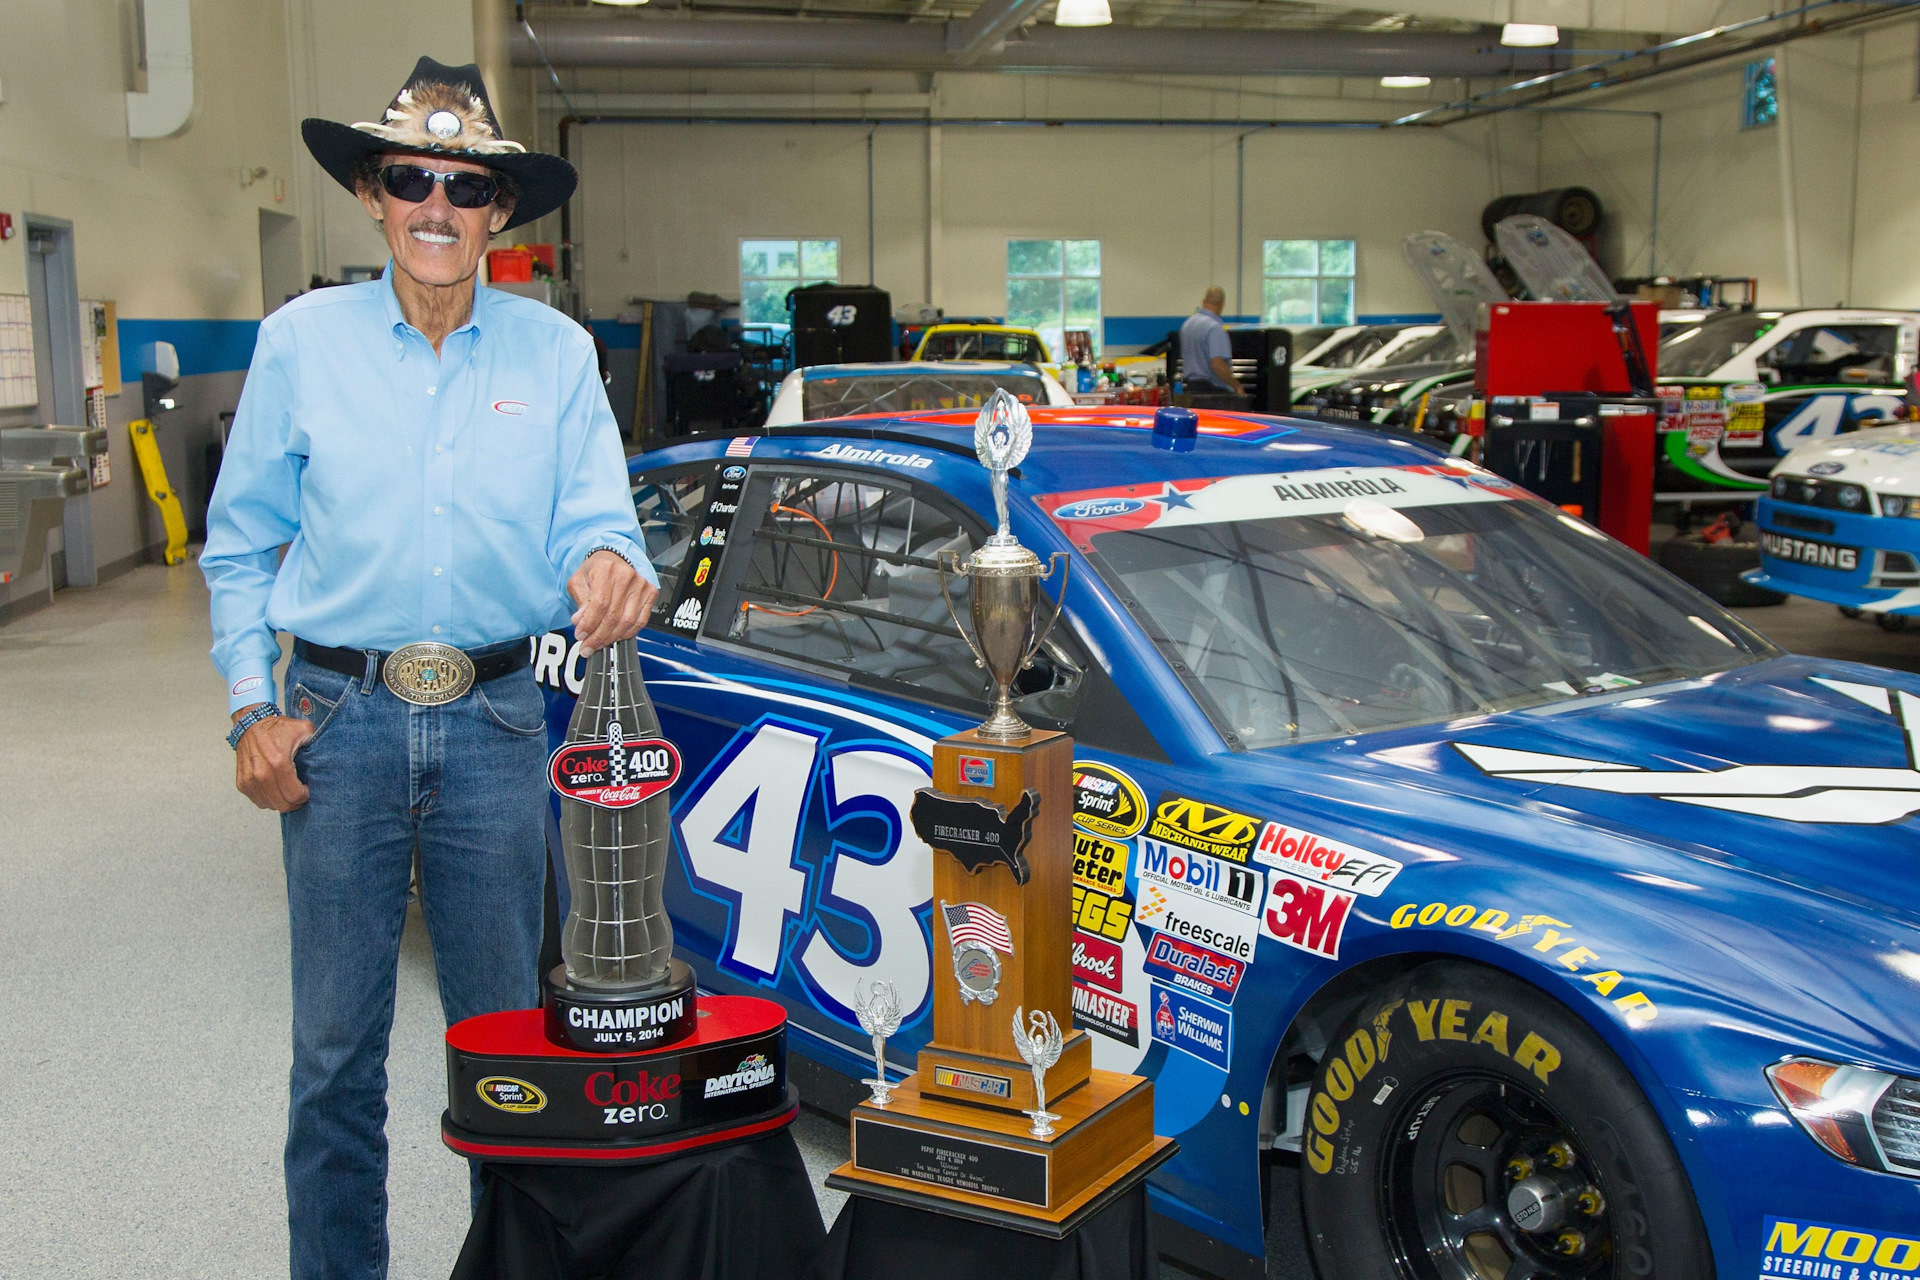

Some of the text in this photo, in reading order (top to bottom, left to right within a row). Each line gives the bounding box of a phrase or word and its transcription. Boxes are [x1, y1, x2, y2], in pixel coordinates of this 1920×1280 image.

[827, 305, 857, 325] 43
[819, 443, 933, 468] Almirola
[1273, 477, 1407, 501] ALMIROLA
[1074, 501, 1129, 517] Ford
[1762, 533, 1857, 570] MUSTANG
[696, 568, 708, 584] 8
[674, 598, 702, 621] MAC
[673, 618, 700, 630] TOOLS
[410, 692, 431, 702] TIME
[561, 757, 609, 775] Coke
[629, 749, 669, 773] 400
[638, 771, 669, 779] DAYTONA
[1079, 774, 1119, 796] NASCAR
[1078, 791, 1115, 812] Sprint
[934, 825, 1000, 844] FIRECRACKER 400
[1076, 814, 1128, 835] CUP SERIES
[1144, 840, 1219, 892] Mobil
[1256, 852, 1322, 877] THROTTLE BODY
[1259, 824, 1397, 886] Holley EFI
[680, 724, 933, 1022] 43
[1073, 855, 1123, 886] eter
[1097, 882, 1117, 893] GAUGES
[1142, 871, 1168, 884] OFFICIAL
[1170, 879, 1192, 892] MOTOR
[1193, 887, 1204, 896] OIL
[1211, 893, 1251, 911] LUBRICANTS
[1266, 879, 1352, 956] 3M
[1164, 911, 1250, 957] freescale
[1073, 942, 1116, 980] brock
[1154, 940, 1238, 987] Duralast
[1173, 973, 1214, 995] BRAKES
[568, 998, 684, 1029] CHAMPION
[1075, 1012, 1105, 1031] TECHNOLOGY
[1105, 1024, 1129, 1038] COMPANY
[1178, 1006, 1224, 1037] SHERWIN
[594, 1027, 664, 1043] JULY 5, 2014
[1407, 999, 1561, 1085] YEAR
[495, 1084, 519, 1092] NASCAR
[584, 1070, 681, 1106] Coke
[704, 1077, 775, 1099] INTERNATIONAL SPEEDWAY
[705, 1064, 775, 1092] DAYTONA
[959, 1074, 1004, 1095] NASCAR
[499, 1093, 523, 1102] Sprint
[603, 1103, 666, 1124] zero
[1407, 1095, 1441, 1140] SET-UP
[1516, 1203, 1540, 1222] STD HUB
[1765, 1221, 1920, 1271] MOO
[1763, 1256, 1842, 1280] STEERING
[1849, 1268, 1860, 1280] &
